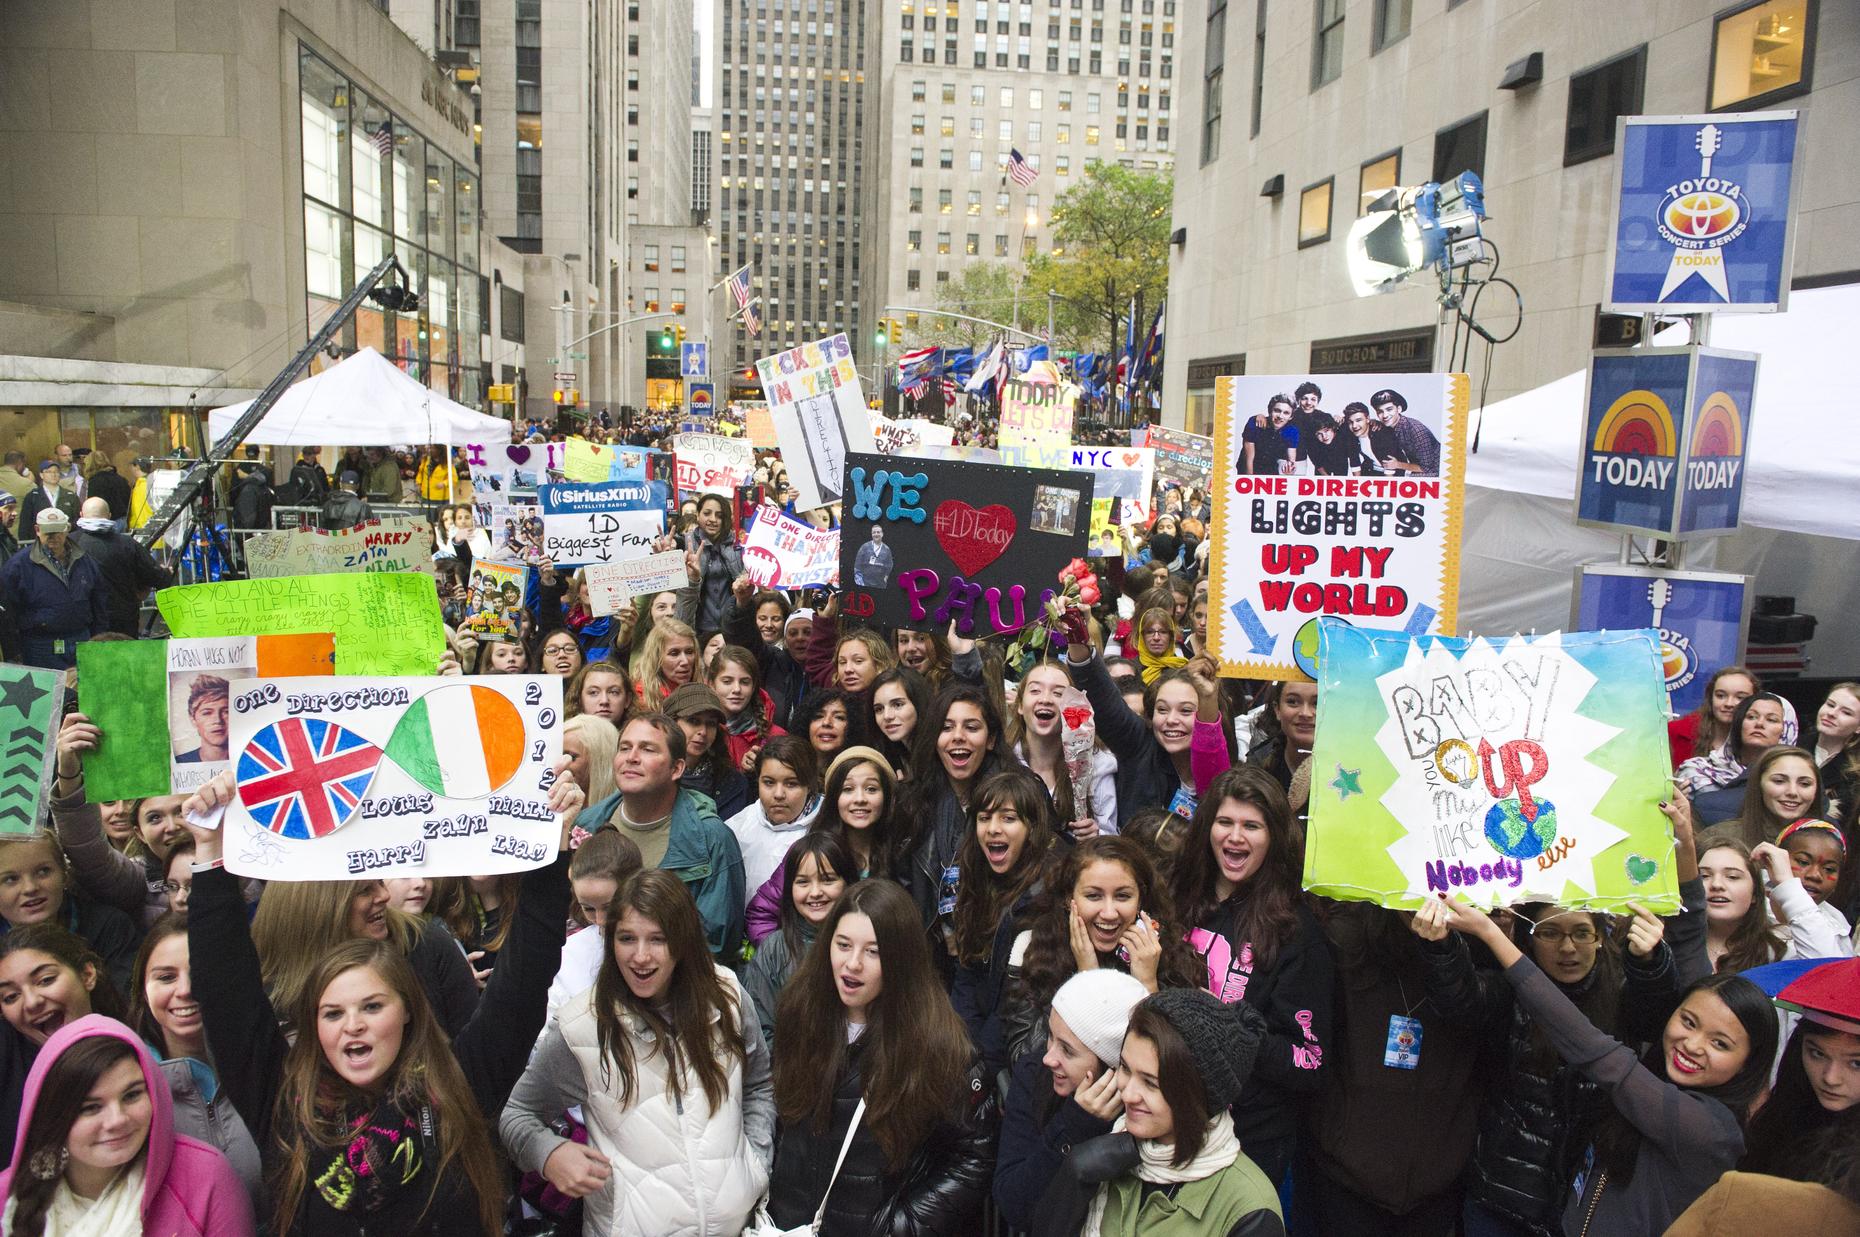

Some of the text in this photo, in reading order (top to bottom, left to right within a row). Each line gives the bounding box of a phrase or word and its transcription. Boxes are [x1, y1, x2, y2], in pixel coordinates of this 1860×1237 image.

[1666, 178, 1741, 199] TOYOTA
[1658, 223, 1747, 249] CONCERT SERIES
[1675, 256, 1721, 265] TODAY
[757, 334, 850, 382] TICKETS
[768, 380, 794, 408] IN
[1006, 379, 1070, 407] TODAY
[1072, 451, 1112, 468] NYC
[678, 464, 701, 487] 1D
[1592, 456, 1673, 491] TODAY
[1688, 461, 1741, 491] TODAY
[851, 467, 929, 524] WE
[1235, 478, 1440, 499] ONE DIRECTION
[588, 513, 620, 534] 1D
[781, 521, 800, 535] ONE
[934, 508, 1014, 552] #1DToday
[1251, 498, 1425, 538] LIGHTS
[296, 543, 366, 556] EXTRAORDIN
[365, 531, 412, 548] HARRY
[344, 545, 388, 567] ZAYN
[548, 535, 613, 557] Biggest
[365, 557, 412, 572] NIALL
[1262, 544, 1394, 578] UP MY
[161, 579, 317, 605] I YOU AND ALL
[842, 592, 875, 618] 1D
[1260, 581, 1408, 617] WORLD
[164, 593, 350, 619] THE LITTLE THINGS
[1659, 628, 1690, 650] OTA
[171, 644, 247, 668] HORAN HUGS NOT
[1666, 672, 1694, 691] ERIES
[1392, 654, 1561, 760] BABY
[1477, 737, 1549, 822] UP
[361, 793, 435, 818] Louis
[1433, 821, 1480, 858] like
[348, 839, 426, 873] Harry
[1426, 836, 1576, 892] Nobody else
[421, 1106, 432, 1137] Nikon
